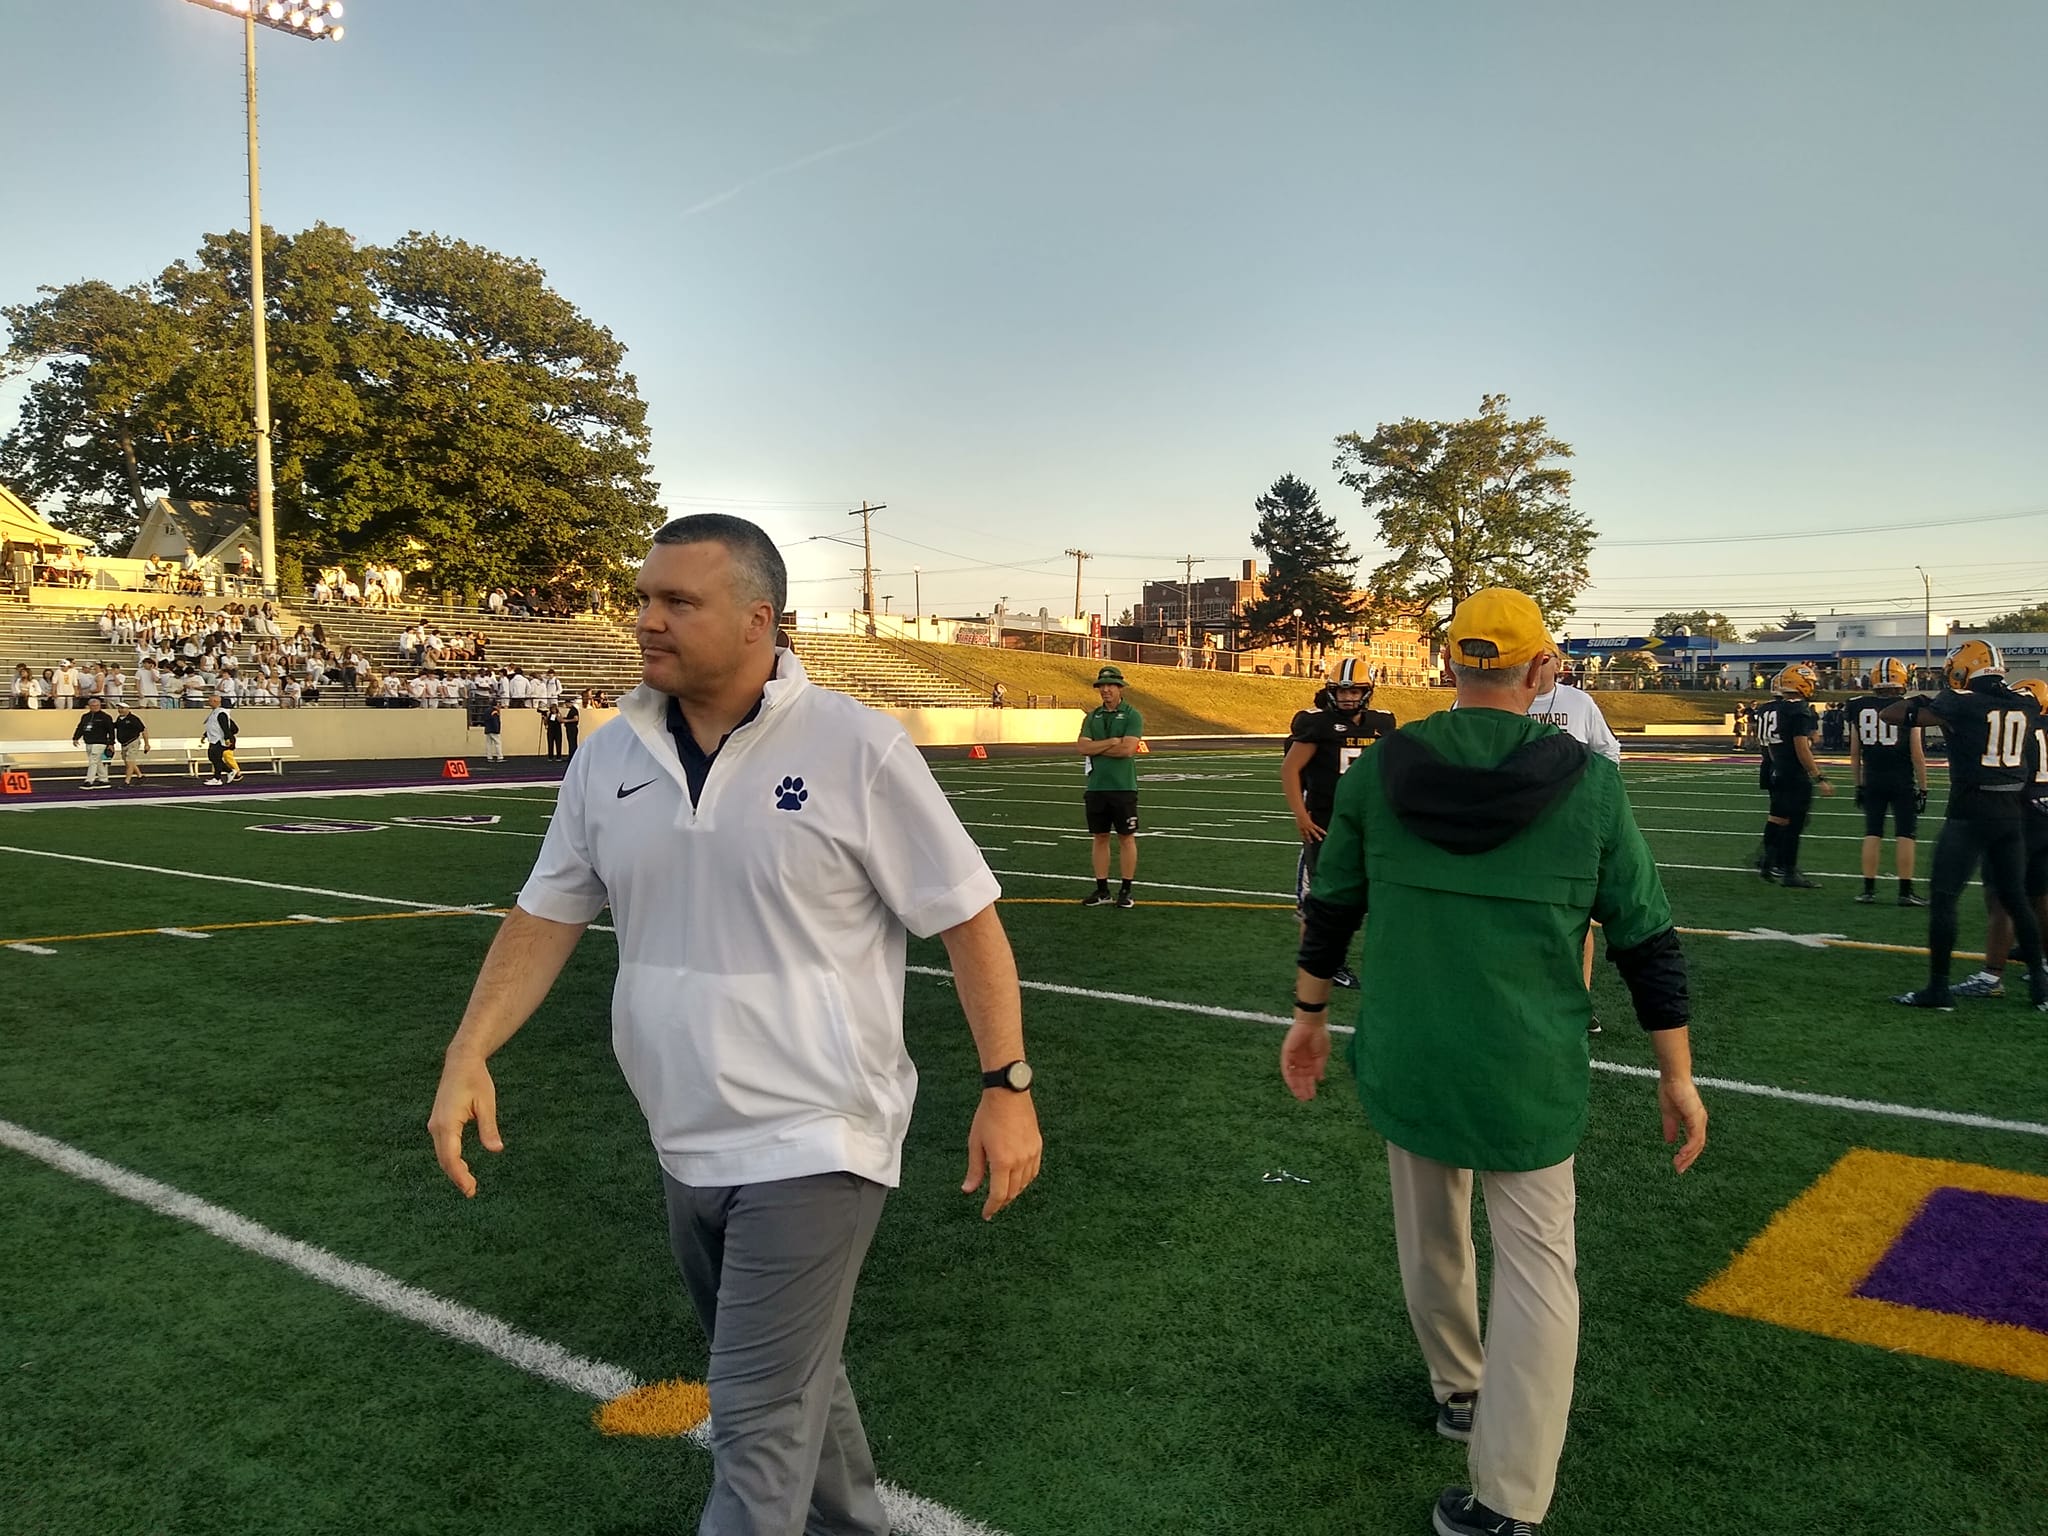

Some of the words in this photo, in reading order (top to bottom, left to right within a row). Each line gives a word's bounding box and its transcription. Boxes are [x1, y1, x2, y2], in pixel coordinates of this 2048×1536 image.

[1587, 638, 1630, 647] SUNOCO
[1527, 713, 1568, 726] DWARD
[1859, 708, 1898, 746] 80
[1981, 709, 2027, 768] 10
[450, 762, 466, 775] 30
[7, 775, 28, 791] 40
